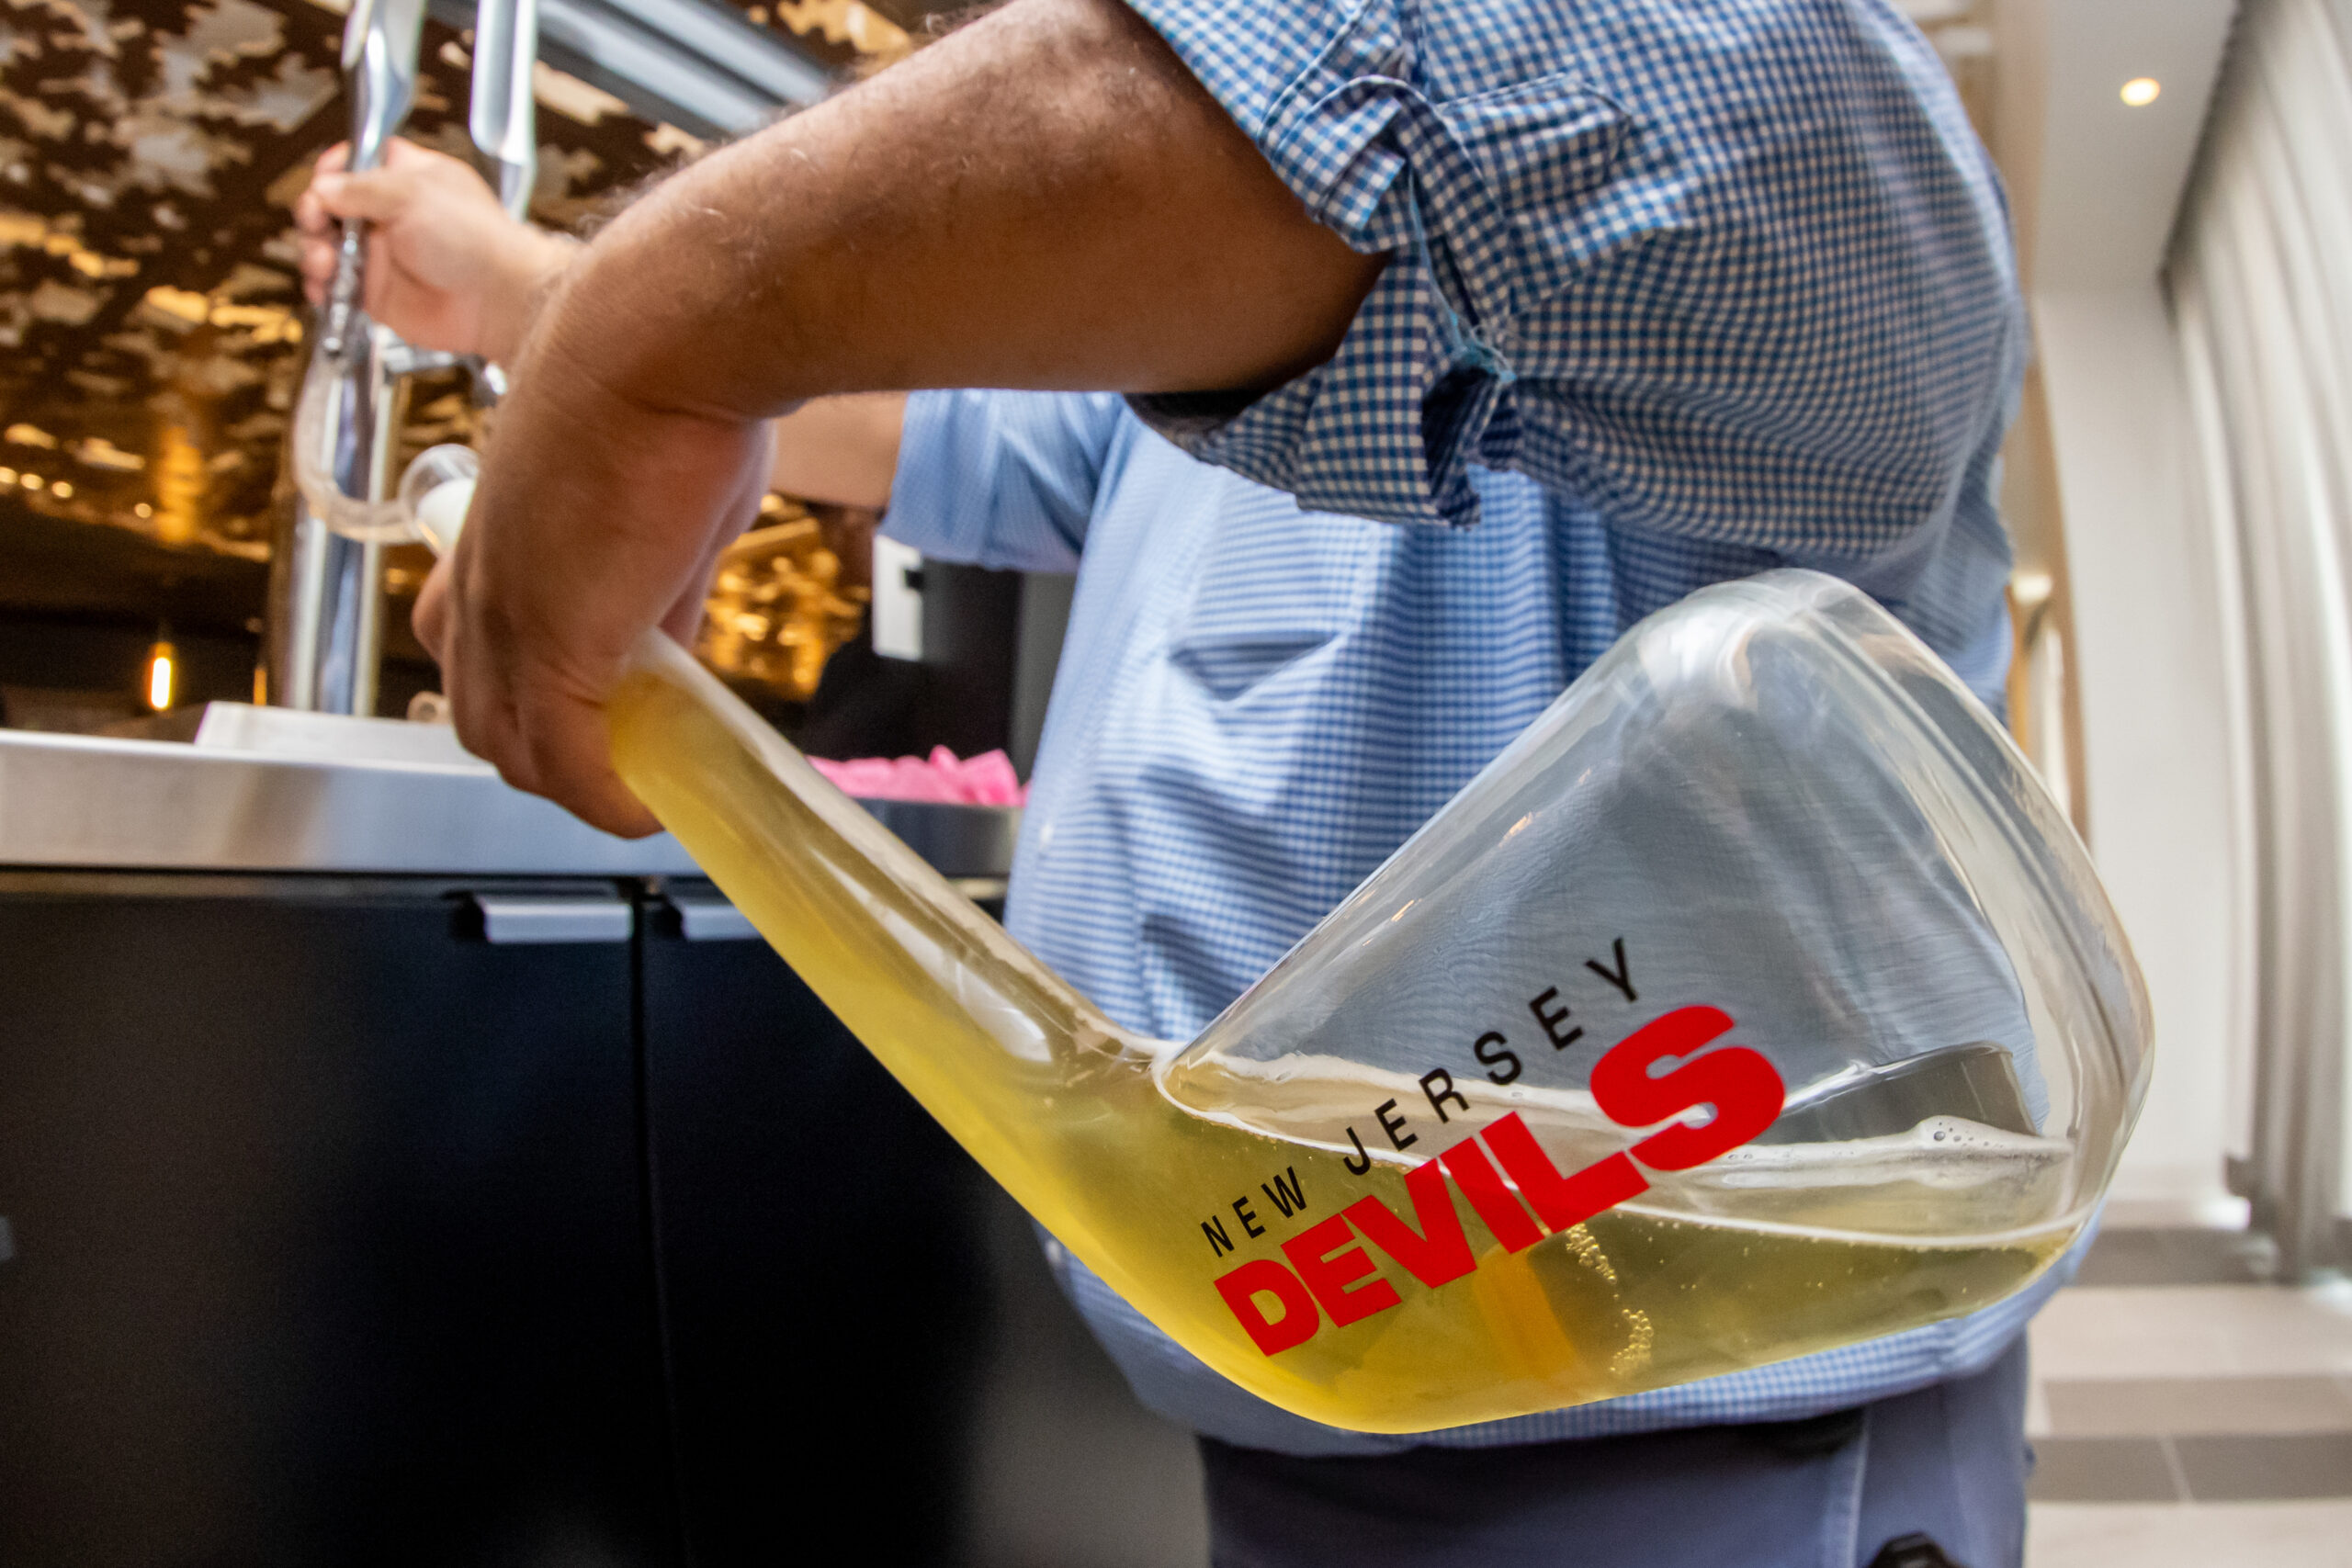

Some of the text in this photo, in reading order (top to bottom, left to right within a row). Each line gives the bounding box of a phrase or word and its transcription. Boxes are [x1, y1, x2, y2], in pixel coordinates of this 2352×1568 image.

[1200, 937, 1638, 1258] NEW JERSEY
[1213, 1005, 1785, 1357] DEVILS
